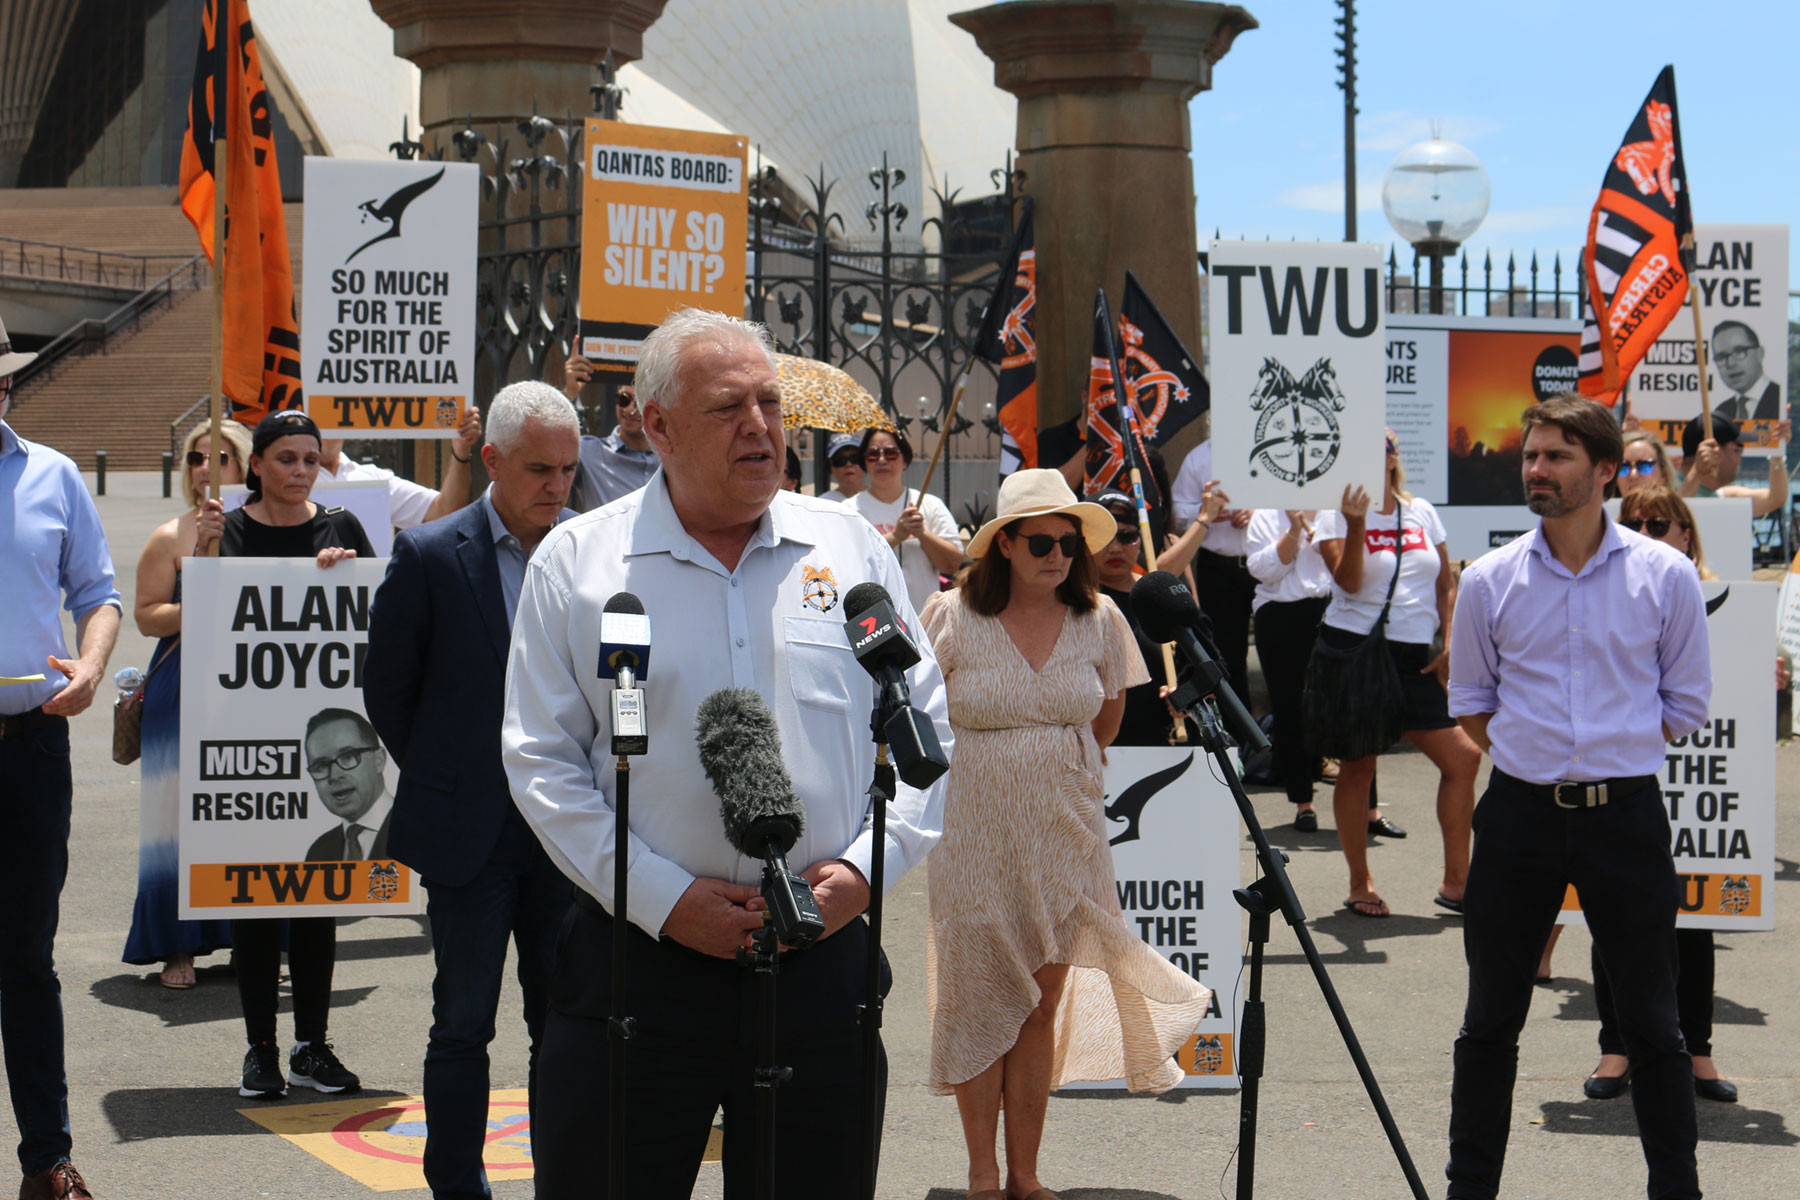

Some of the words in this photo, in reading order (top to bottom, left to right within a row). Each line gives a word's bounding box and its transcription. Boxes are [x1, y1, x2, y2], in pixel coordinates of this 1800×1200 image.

[597, 150, 665, 179] QANTAS
[671, 157, 733, 184] BOARD:
[607, 202, 677, 248] WHY
[685, 210, 725, 253] SO
[604, 244, 725, 293] SILENT?
[1693, 242, 1753, 270] LAN
[331, 269, 365, 294] SO
[374, 270, 449, 296] MUCH
[1690, 277, 1762, 307] YCE
[338, 299, 387, 324] FOR
[395, 301, 442, 325] THE
[1212, 265, 1379, 338] TWU
[328, 329, 411, 354] SPIRIT
[419, 330, 450, 354] OF
[1647, 343, 1706, 364] MUS
[317, 359, 458, 384] AUSTRALIA
[1535, 366, 1579, 378] DONATE
[1540, 381, 1576, 392] TODAY
[333, 397, 427, 427] TWU
[231, 585, 369, 632] ALAN
[855, 624, 892, 649] NEWS
[858, 616, 877, 635] 7
[206, 745, 298, 776] MUST
[1665, 754, 1728, 785] THE
[192, 791, 309, 821] RESIGN
[1696, 791, 1740, 822] OF
[225, 862, 357, 904] TWU
[1135, 916, 1198, 946] THE
